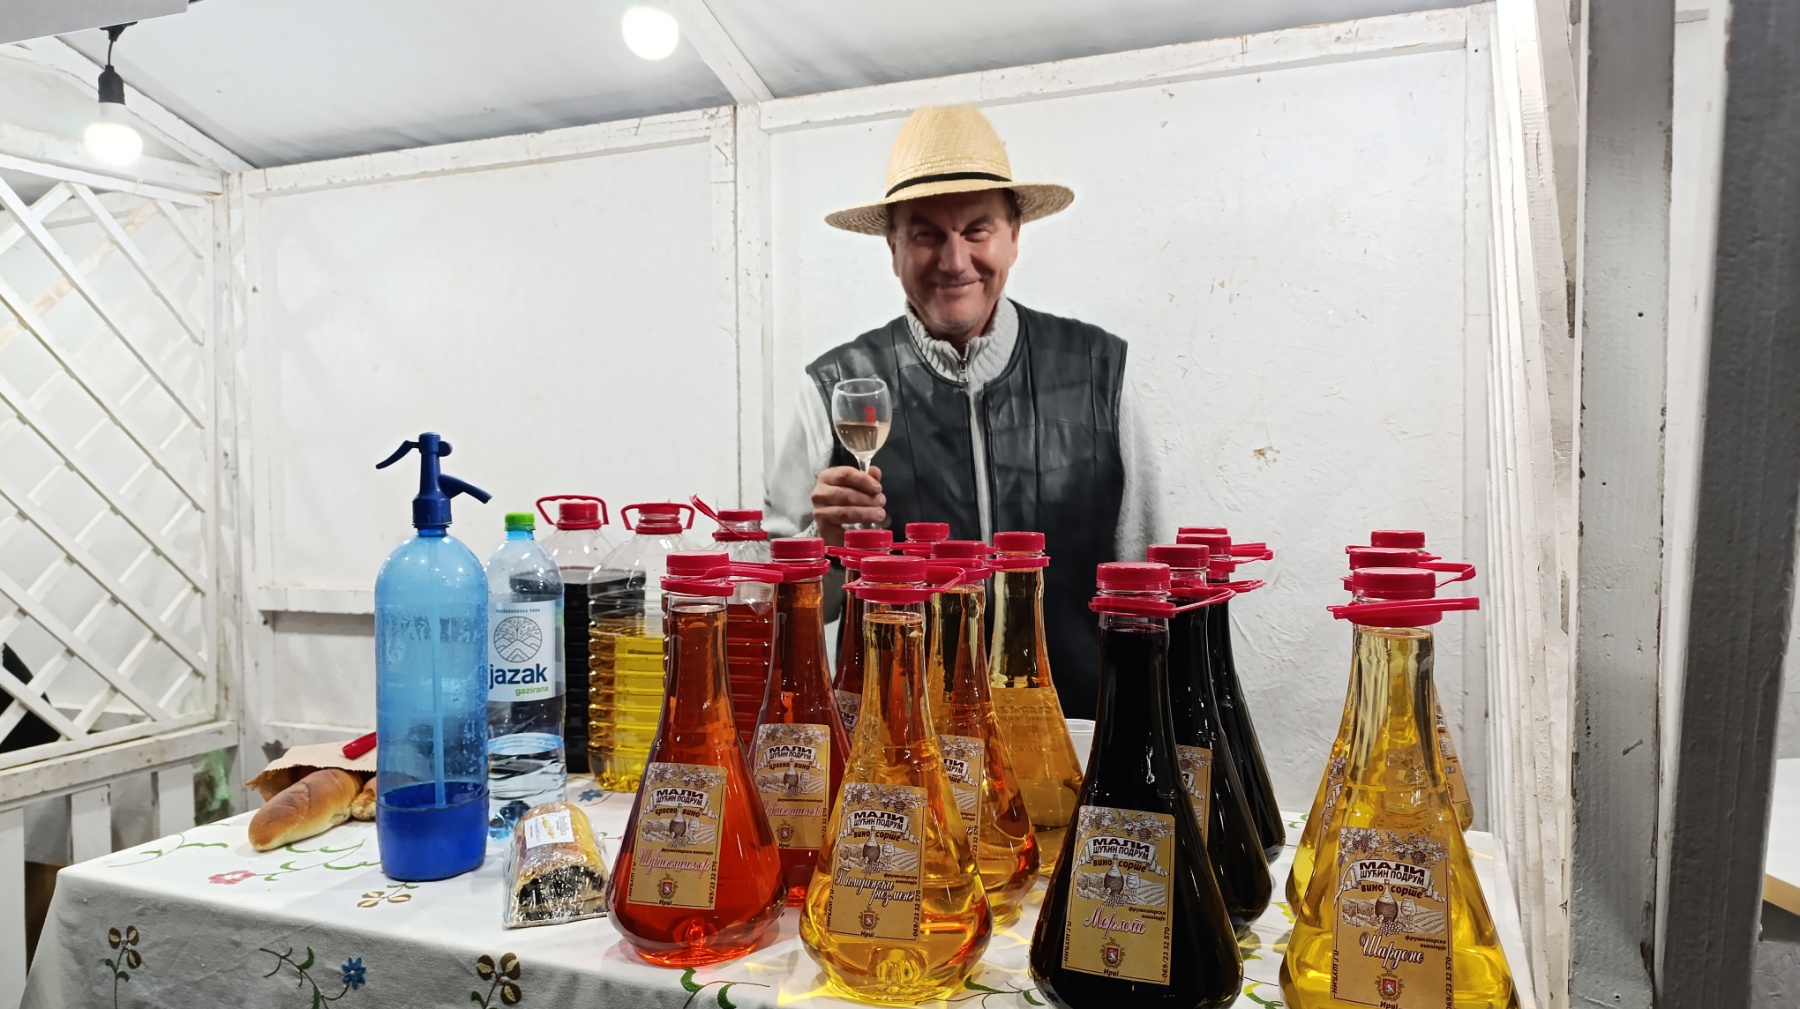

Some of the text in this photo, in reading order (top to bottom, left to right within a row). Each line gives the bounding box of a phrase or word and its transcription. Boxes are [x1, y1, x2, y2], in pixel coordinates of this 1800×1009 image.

[489, 663, 548, 689] jazak
[515, 686, 549, 696] gazirana
[769, 745, 812, 755] МАЛИ
[769, 751, 812, 760] ШУЋИН ПОДРУМ
[768, 762, 790, 771] црвено
[944, 758, 964, 768] ЛИ
[656, 788, 703, 799] МАЛИ
[656, 794, 703, 806] ШУЋИН ПОДРУМ
[655, 806, 700, 818] црвено вино
[854, 811, 904, 824] МАЛИ
[853, 818, 904, 831] ШУЋИН ПОДРУМ
[875, 831, 901, 842] сорше
[1092, 838, 1150, 853] МАЛИ
[1092, 845, 1149, 860] ШУЋИН ПОДРУМ
[1093, 859, 1147, 873] вино сорше
[1359, 861, 1425, 877] МАЛИ
[1360, 869, 1425, 886] ШУЋИН ПОДРУМ
[708, 881, 716, 904] 069/23
[1361, 884, 1423, 899] вино сорше
[914, 903, 920, 911] 32
[912, 912, 920, 937] 069/23
[1163, 941, 1170, 950] 32
[1161, 952, 1169, 978] 069/23
[1103, 968, 1120, 977] Ириг
[1446, 972, 1453, 982] 32
